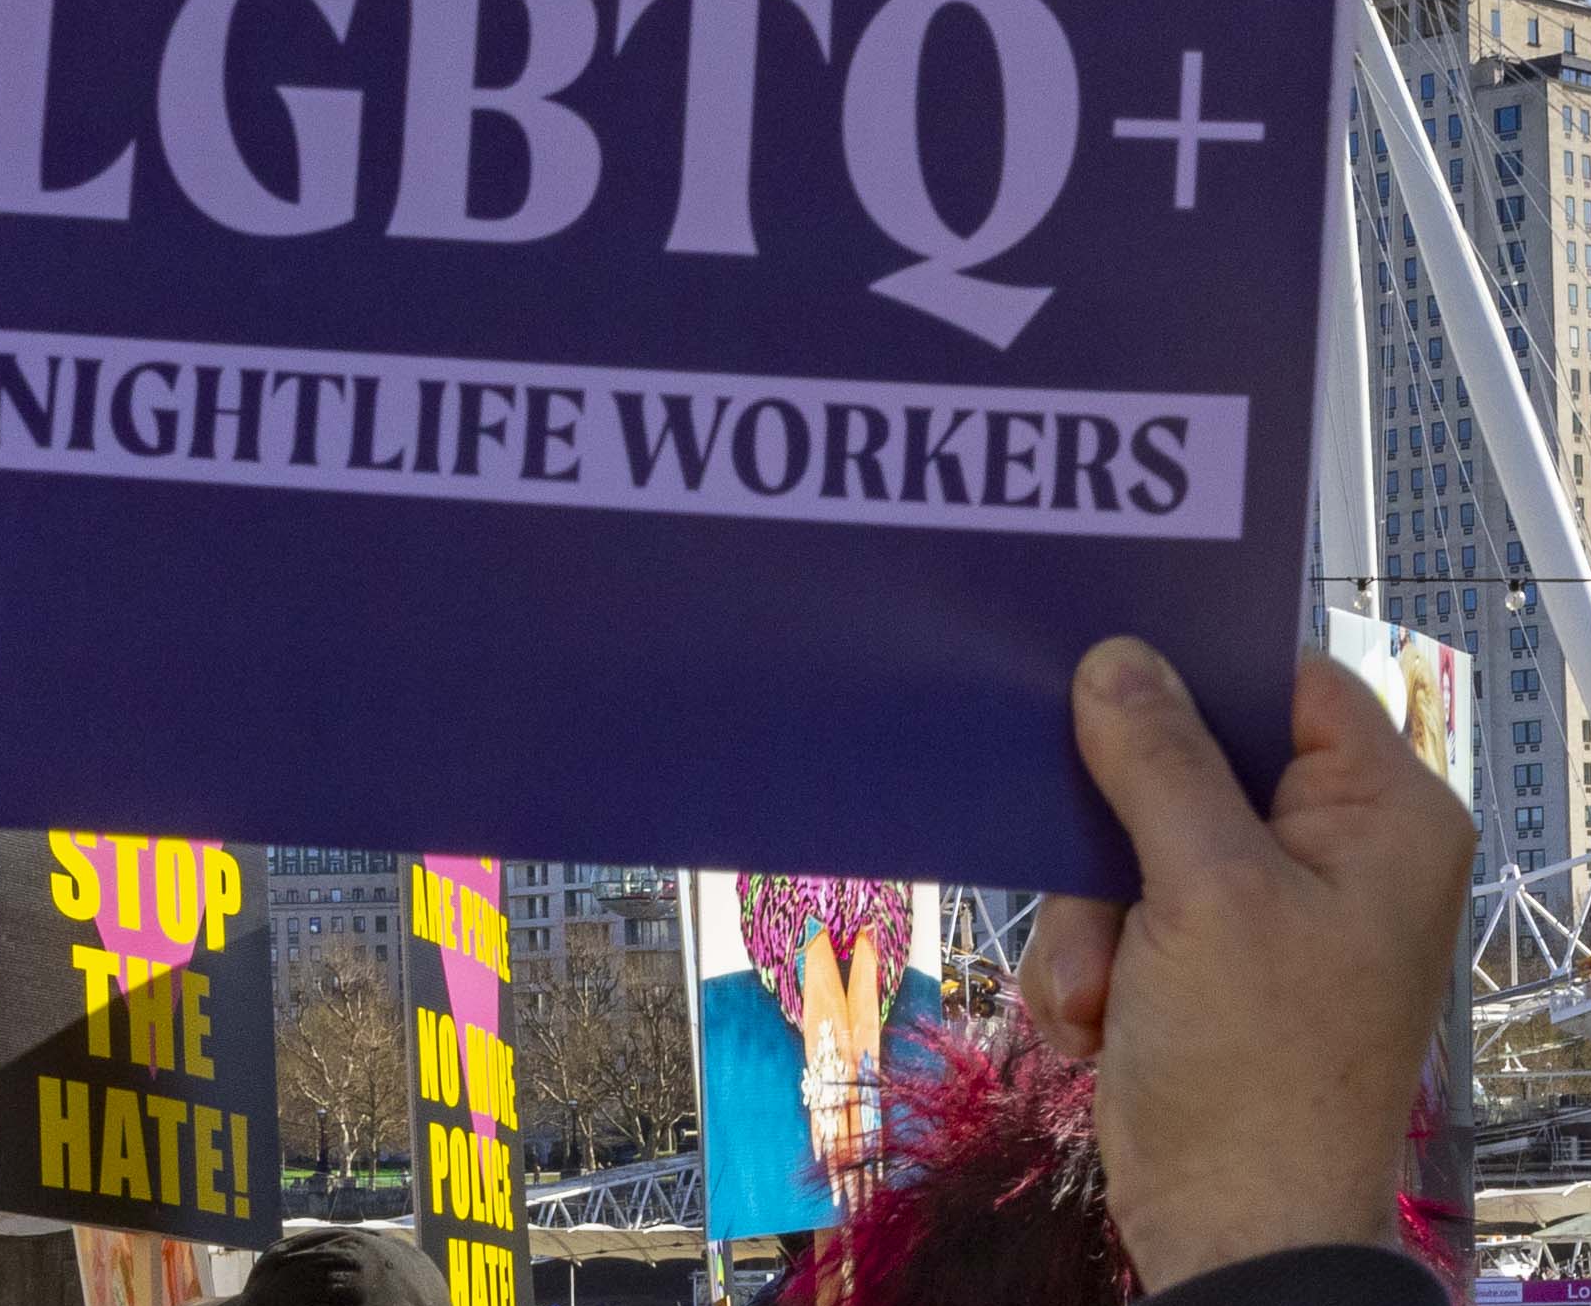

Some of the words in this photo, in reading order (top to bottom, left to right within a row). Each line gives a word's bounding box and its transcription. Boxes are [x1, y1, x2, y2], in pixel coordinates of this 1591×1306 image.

[613, 392, 1192, 520] WORKERS
[48, 829, 242, 951] STOP
[412, 864, 455, 947] ARE
[462, 888, 511, 983] PEOPLE
[71, 944, 216, 1081] THE
[417, 1006, 461, 1109] NO
[465, 1025, 519, 1131] MORE
[38, 1076, 251, 1220] HATE!
[428, 1119, 519, 1232] POLICE
